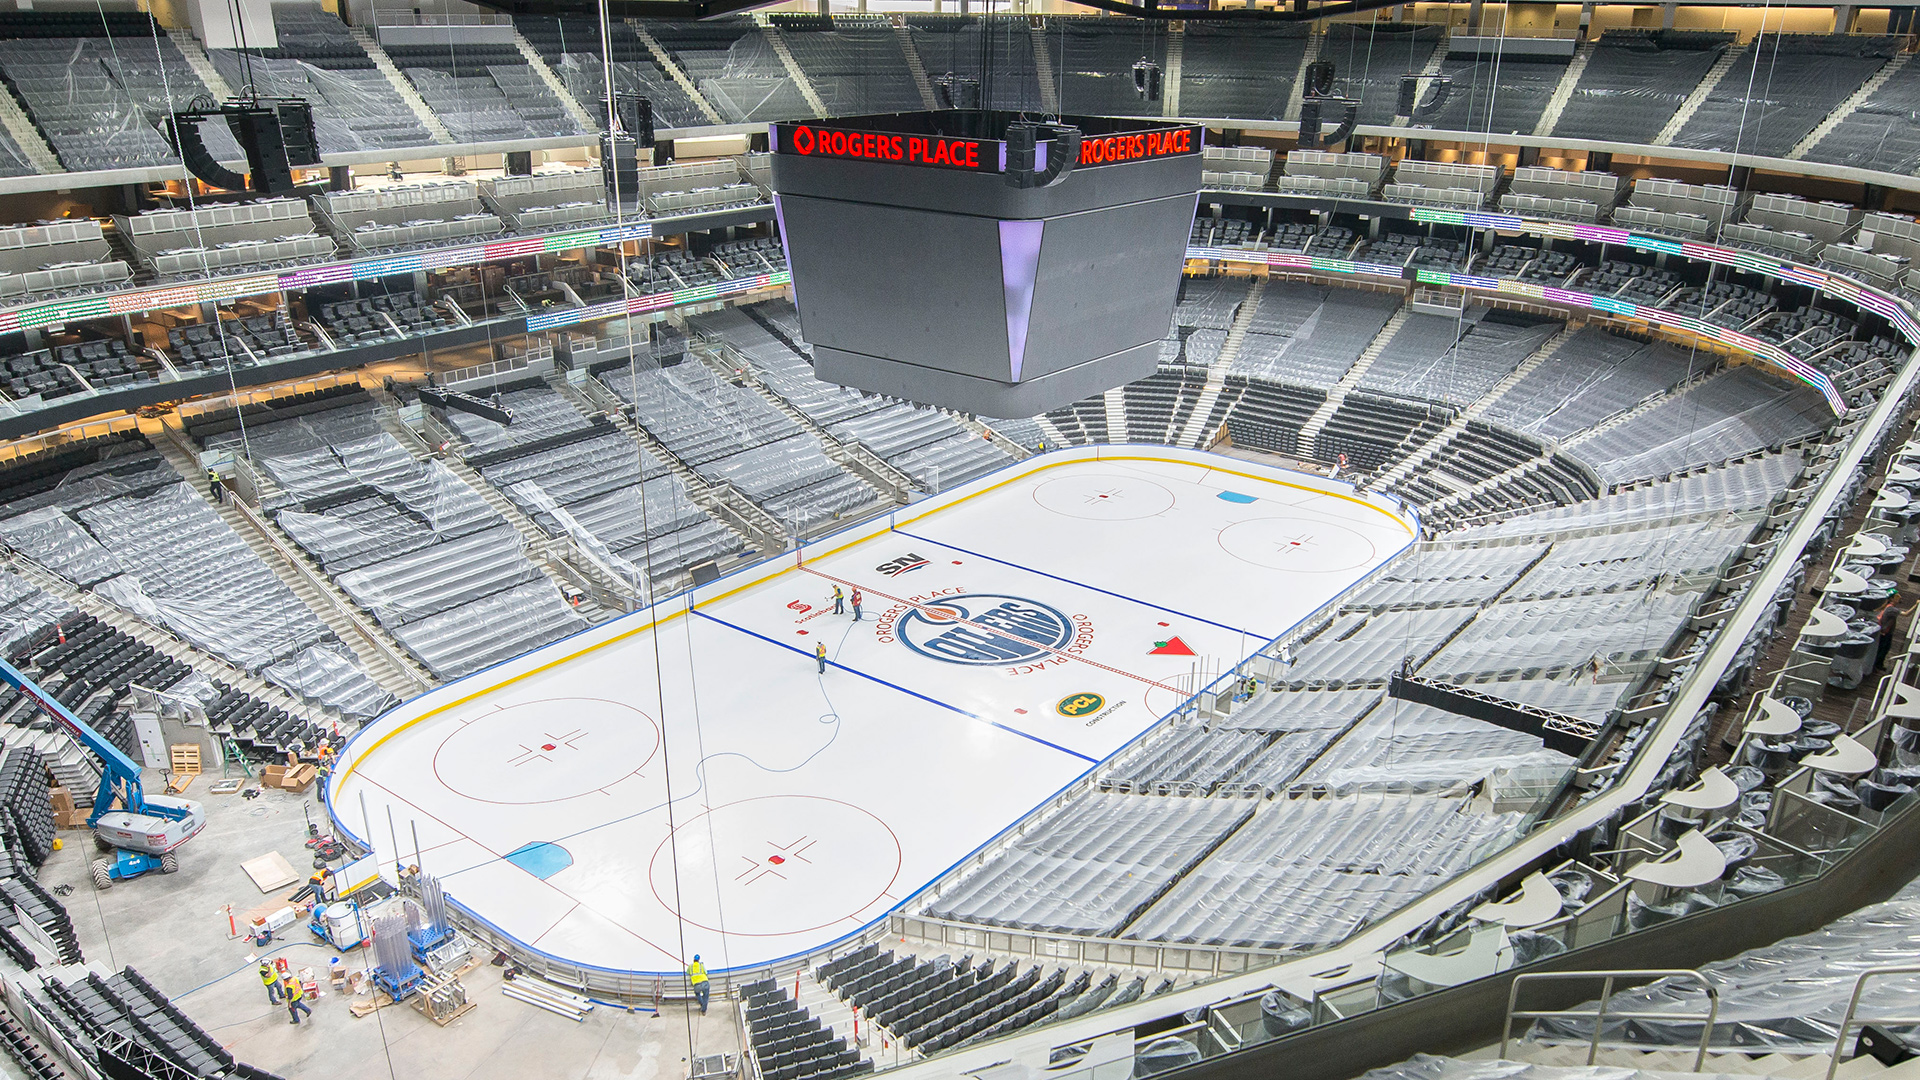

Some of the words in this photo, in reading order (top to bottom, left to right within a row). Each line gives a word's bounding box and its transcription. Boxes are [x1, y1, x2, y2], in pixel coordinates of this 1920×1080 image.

[818, 130, 904, 161] ROGERS
[909, 137, 980, 168] PLACE
[1081, 134, 1145, 164] ROGERS
[1147, 129, 1192, 156] PLACE
[876, 604, 908, 635] ROGERS
[909, 586, 967, 603] PLACE
[1067, 621, 1094, 654] ROGERS
[1005, 655, 1068, 676] PLACE
[1063, 695, 1098, 715] PCL
[1085, 700, 1127, 727] CONSTRUCTION
